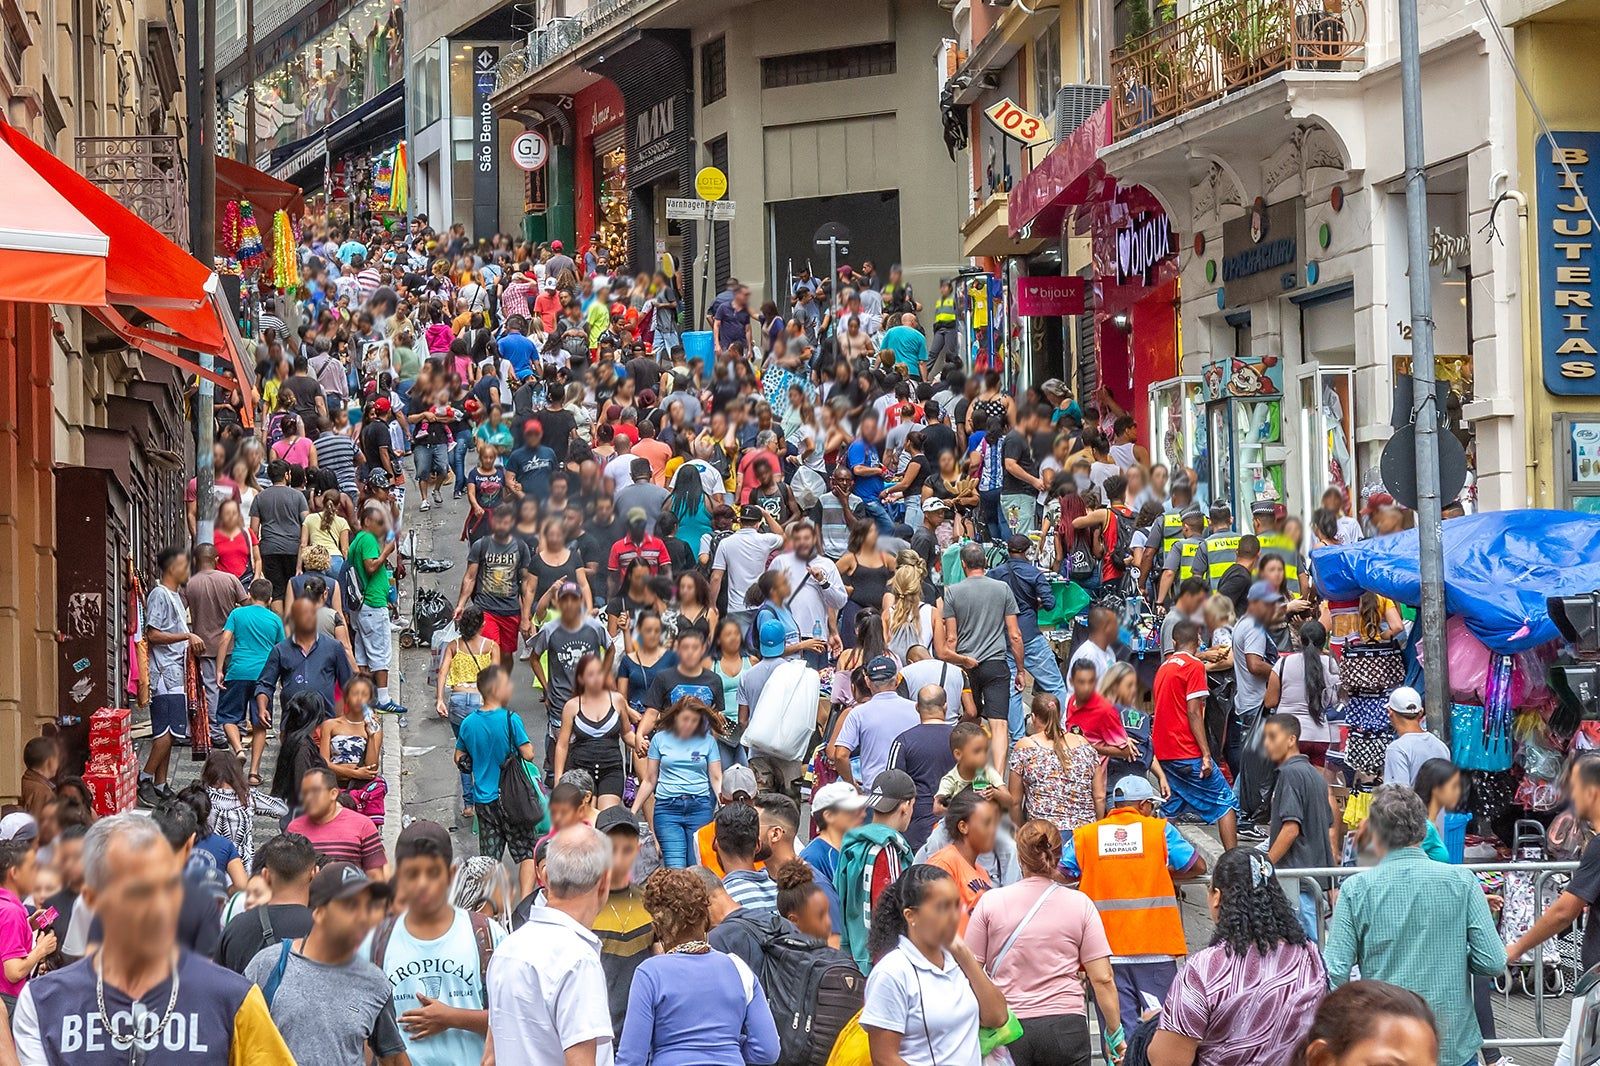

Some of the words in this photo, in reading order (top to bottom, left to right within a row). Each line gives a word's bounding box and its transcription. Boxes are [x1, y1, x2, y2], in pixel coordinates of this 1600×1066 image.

[556, 95, 574, 110] 73
[479, 102, 492, 142] Bento
[994, 101, 1040, 139] 103
[518, 138, 541, 155] GJ
[477, 145, 492, 172] São
[697, 177, 725, 187] LOTEX
[667, 199, 705, 211] Varnhagen
[1131, 210, 1170, 288] bijoux
[1552, 147, 1598, 378] BIJUTERIAS
[1040, 286, 1076, 301] bijoux
[1214, 540, 1241, 548] POLIC
[487, 552, 514, 564] BEER
[388, 958, 475, 988] TROPICAL
